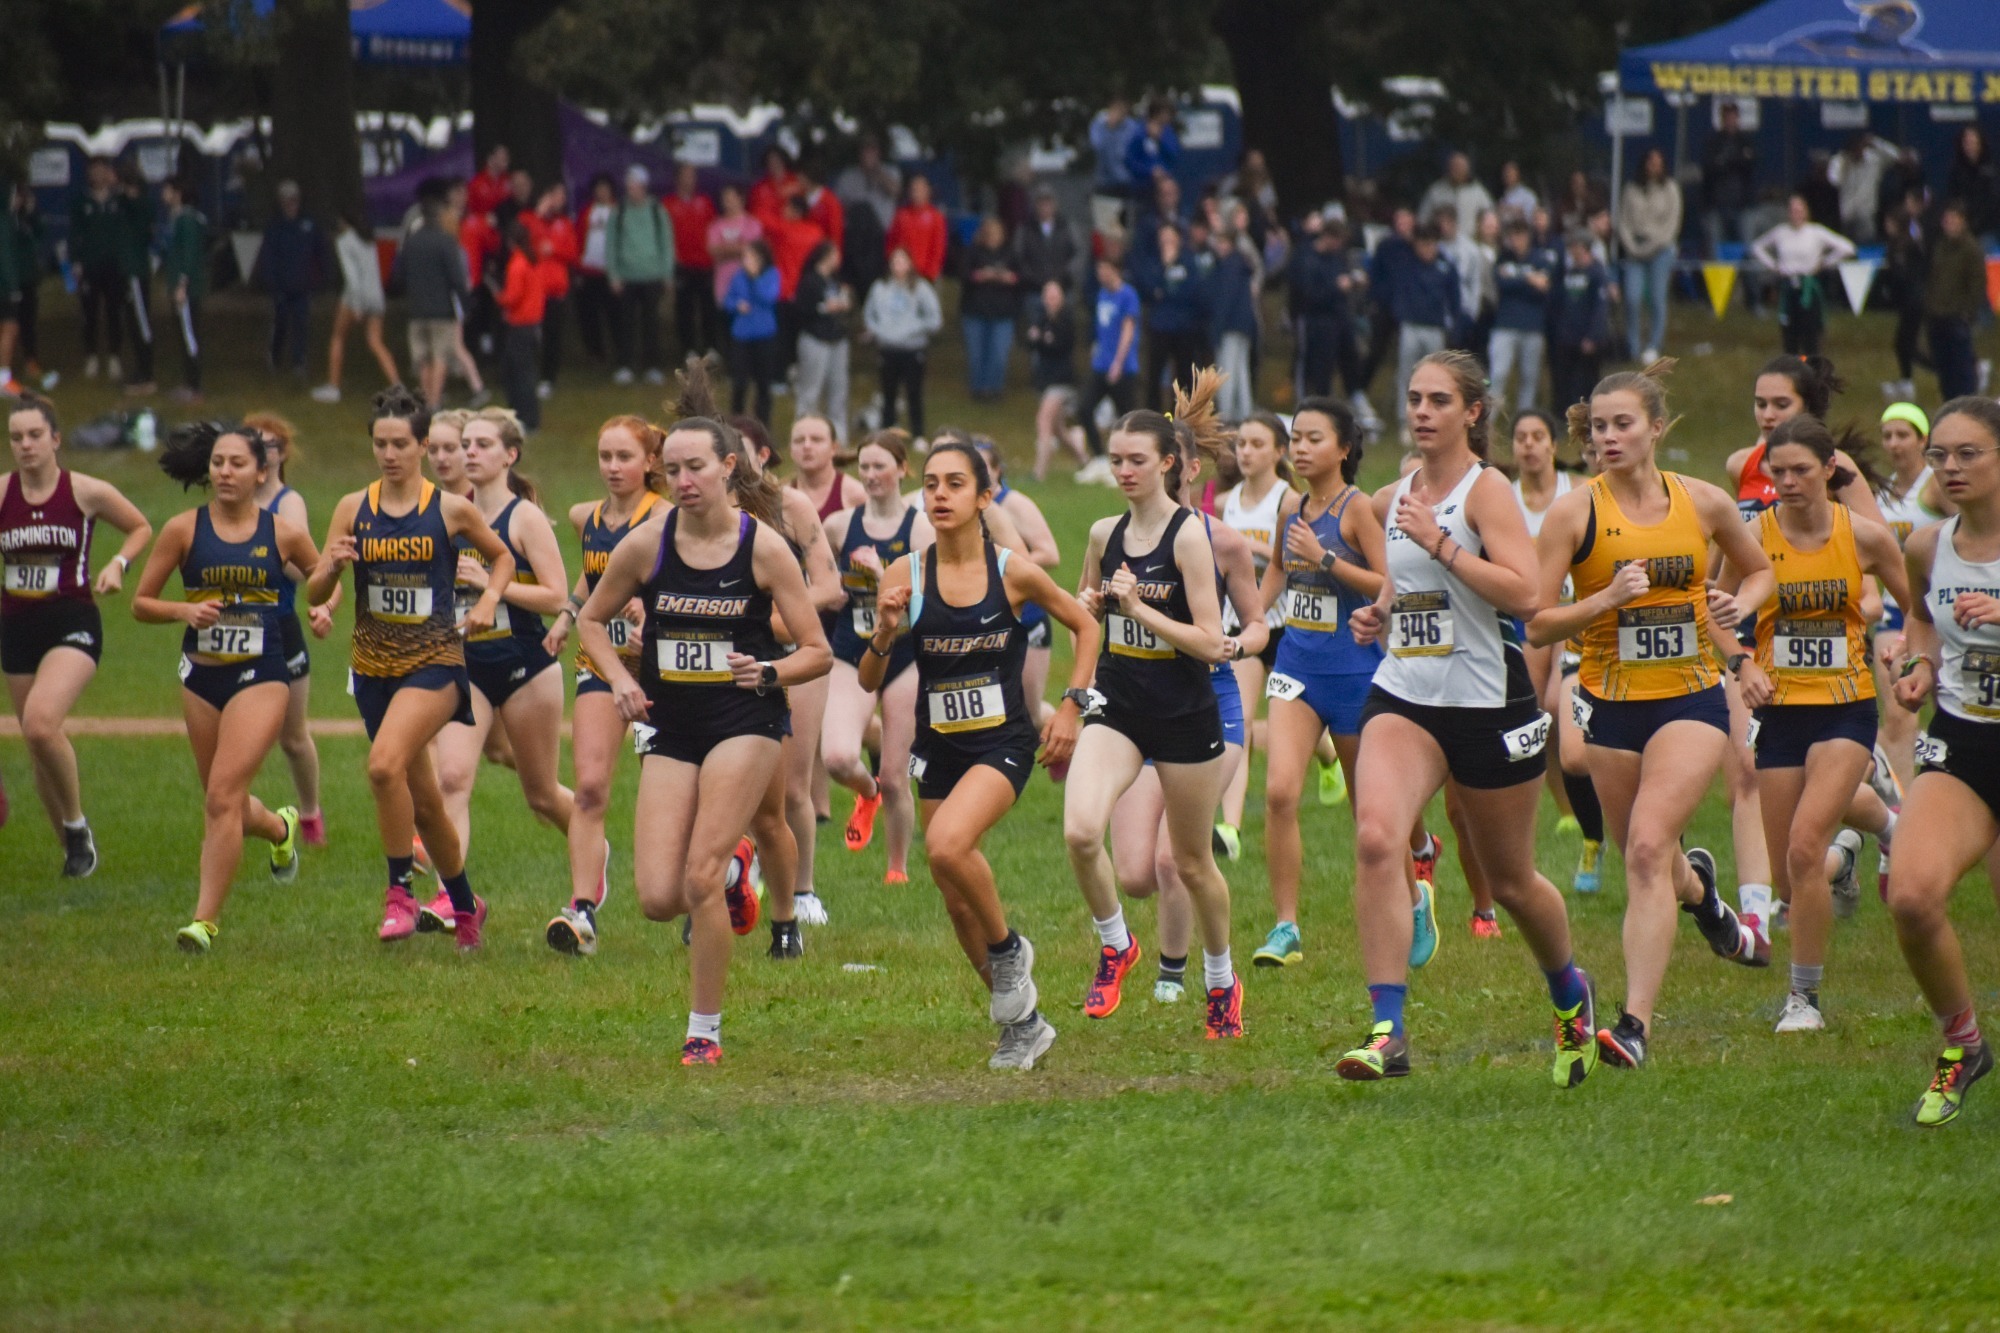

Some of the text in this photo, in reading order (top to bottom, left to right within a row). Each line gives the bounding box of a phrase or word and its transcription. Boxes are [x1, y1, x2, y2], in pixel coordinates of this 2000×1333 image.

[1652, 63, 1859, 98] WORCESTER
[1867, 70, 1974, 101] STATE
[362, 536, 434, 562] UMASSD
[17, 567, 47, 589] 918
[1613, 555, 1694, 576] SOTHERN
[1778, 578, 1848, 596] SOUTHERN
[382, 588, 417, 614] 991
[655, 594, 749, 617] EMERSON
[1293, 593, 1323, 621] 826
[1780, 592, 1848, 613] MAINE
[211, 627, 251, 652] 972
[1400, 612, 1441, 646] 946
[923, 632, 1009, 653] EMERSON
[1636, 626, 1684, 659] 963
[1789, 637, 1833, 667] 958
[675, 641, 714, 671] 821
[943, 689, 985, 722] 818
[1518, 722, 1547, 754] 946
